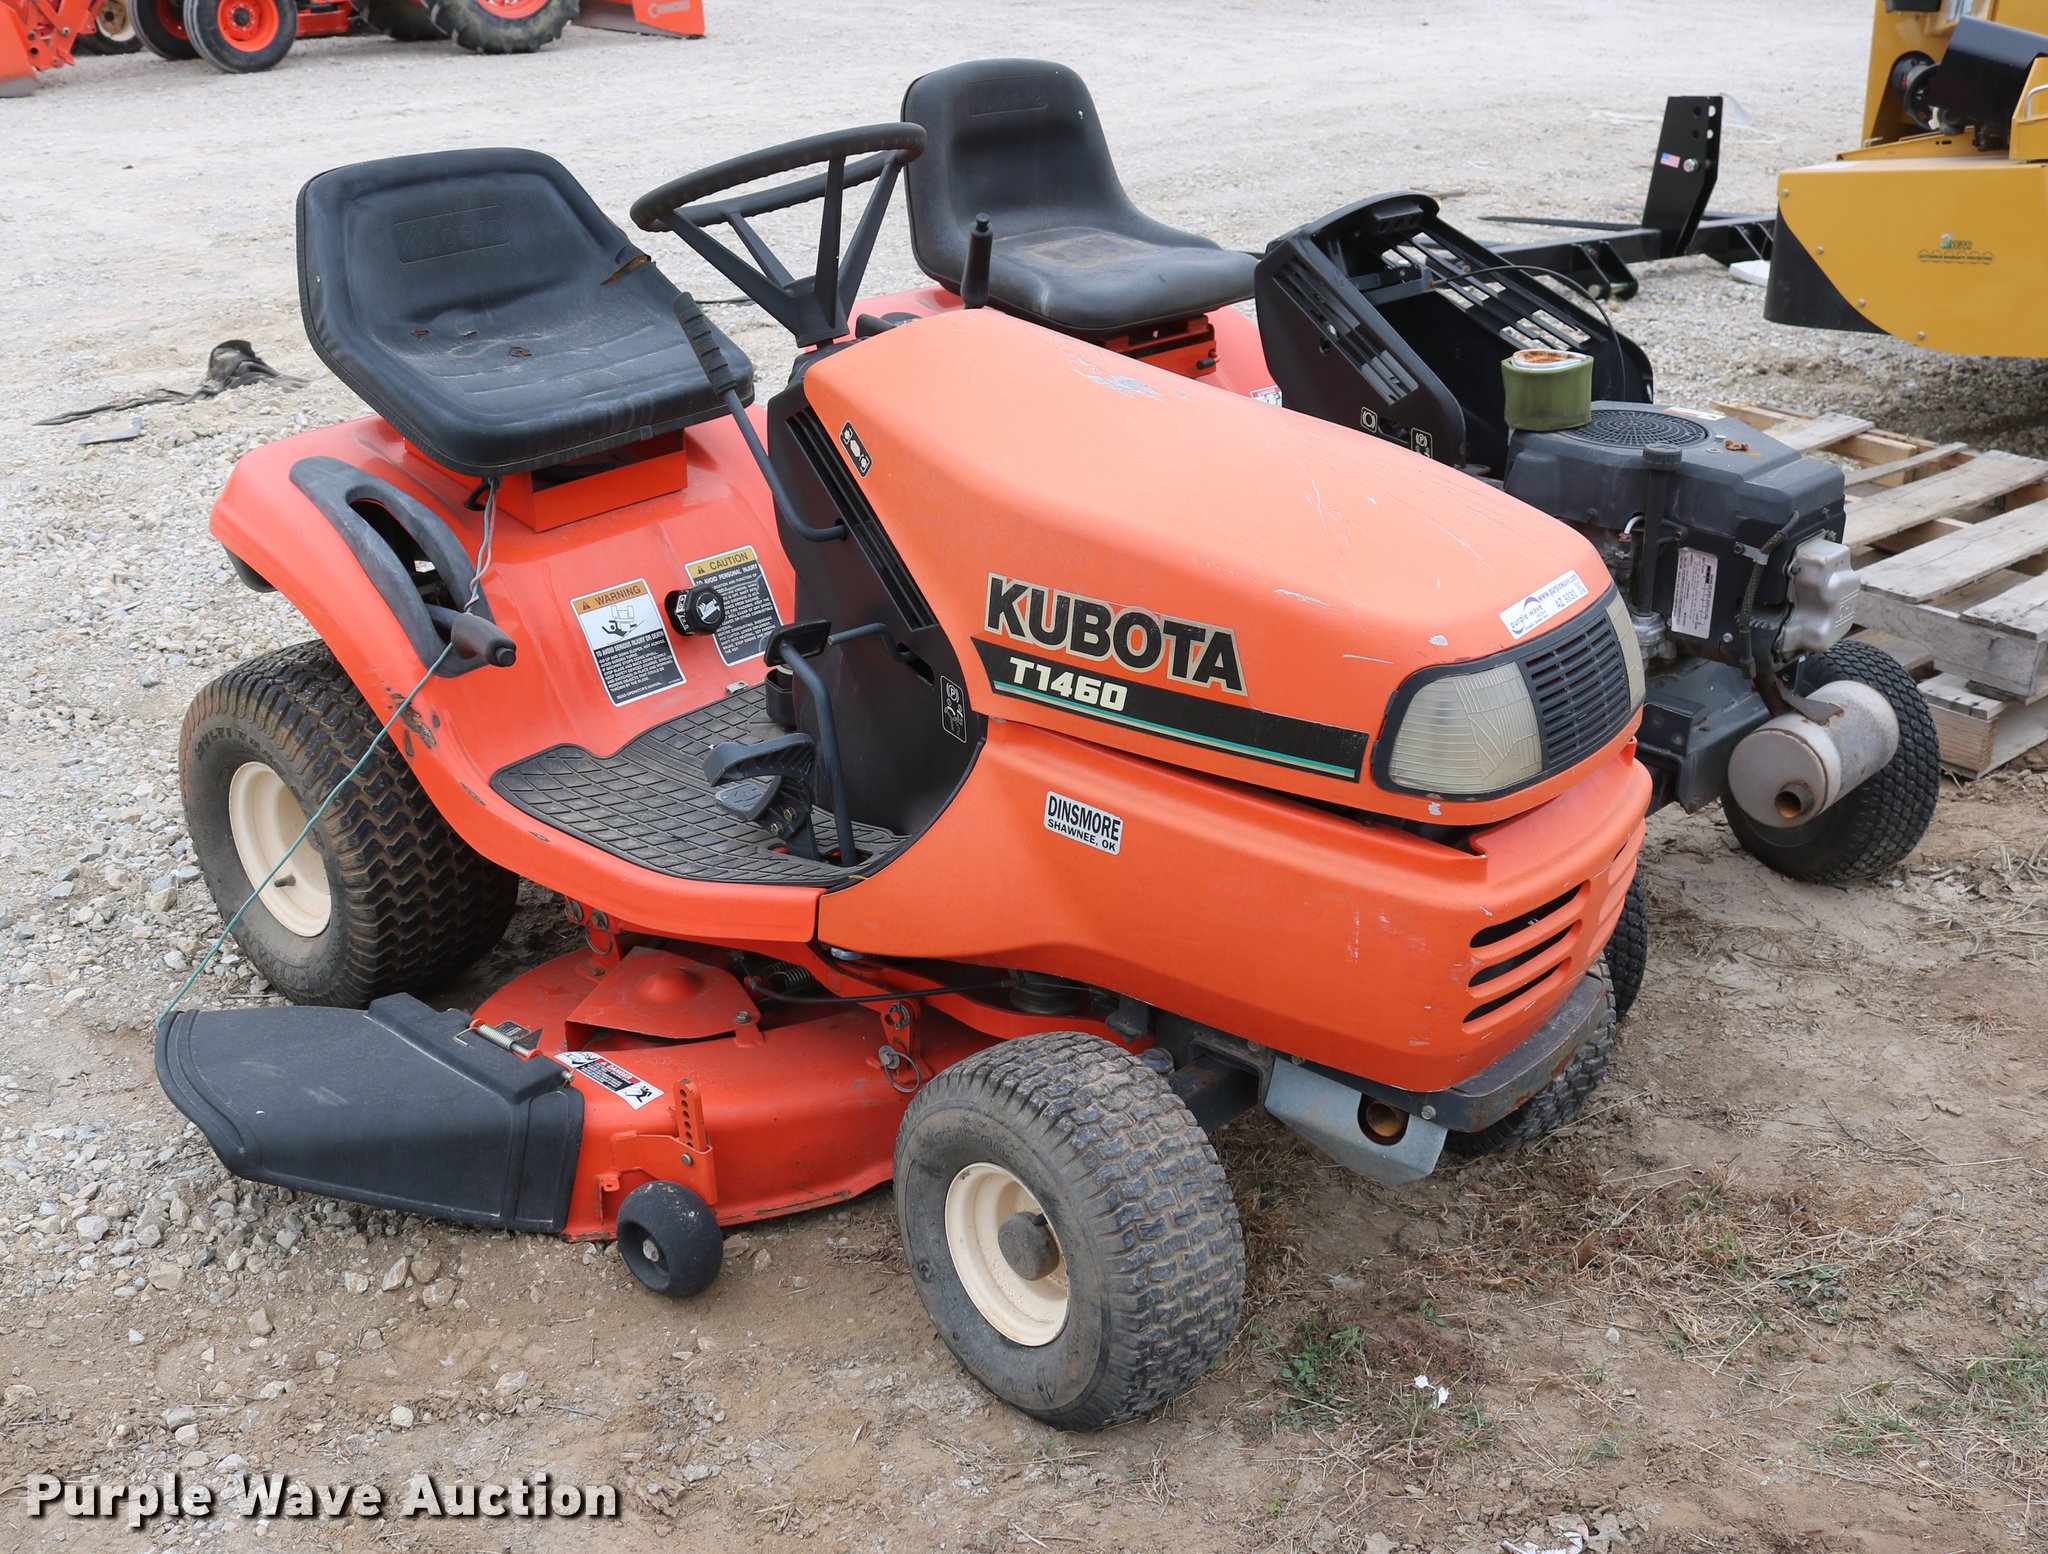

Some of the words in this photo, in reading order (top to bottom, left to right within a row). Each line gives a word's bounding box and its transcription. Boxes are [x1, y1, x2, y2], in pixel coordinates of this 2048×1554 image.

[1940, 233, 1953, 250] 3
[710, 552, 748, 570] CAUTION
[704, 576, 718, 585] AVOID
[718, 568, 742, 580] PERSONAL
[742, 564, 758, 573] INJURY
[595, 585, 640, 606] WARNING
[1555, 598, 1564, 608] AZ
[1510, 613, 1528, 629] purple
[1528, 605, 1542, 616] wave
[602, 647, 615, 656] AVOID
[614, 641, 632, 652] SERIOUS
[631, 636, 646, 646] INJURY
[651, 630, 664, 639] DEATH
[985, 572, 1248, 696] KUBOTA
[1009, 657, 1128, 711] T1460
[1048, 795, 1121, 842] DINSMORE
[1048, 818, 1100, 847] SHAWNEE,
[1101, 839, 1116, 852] OK
